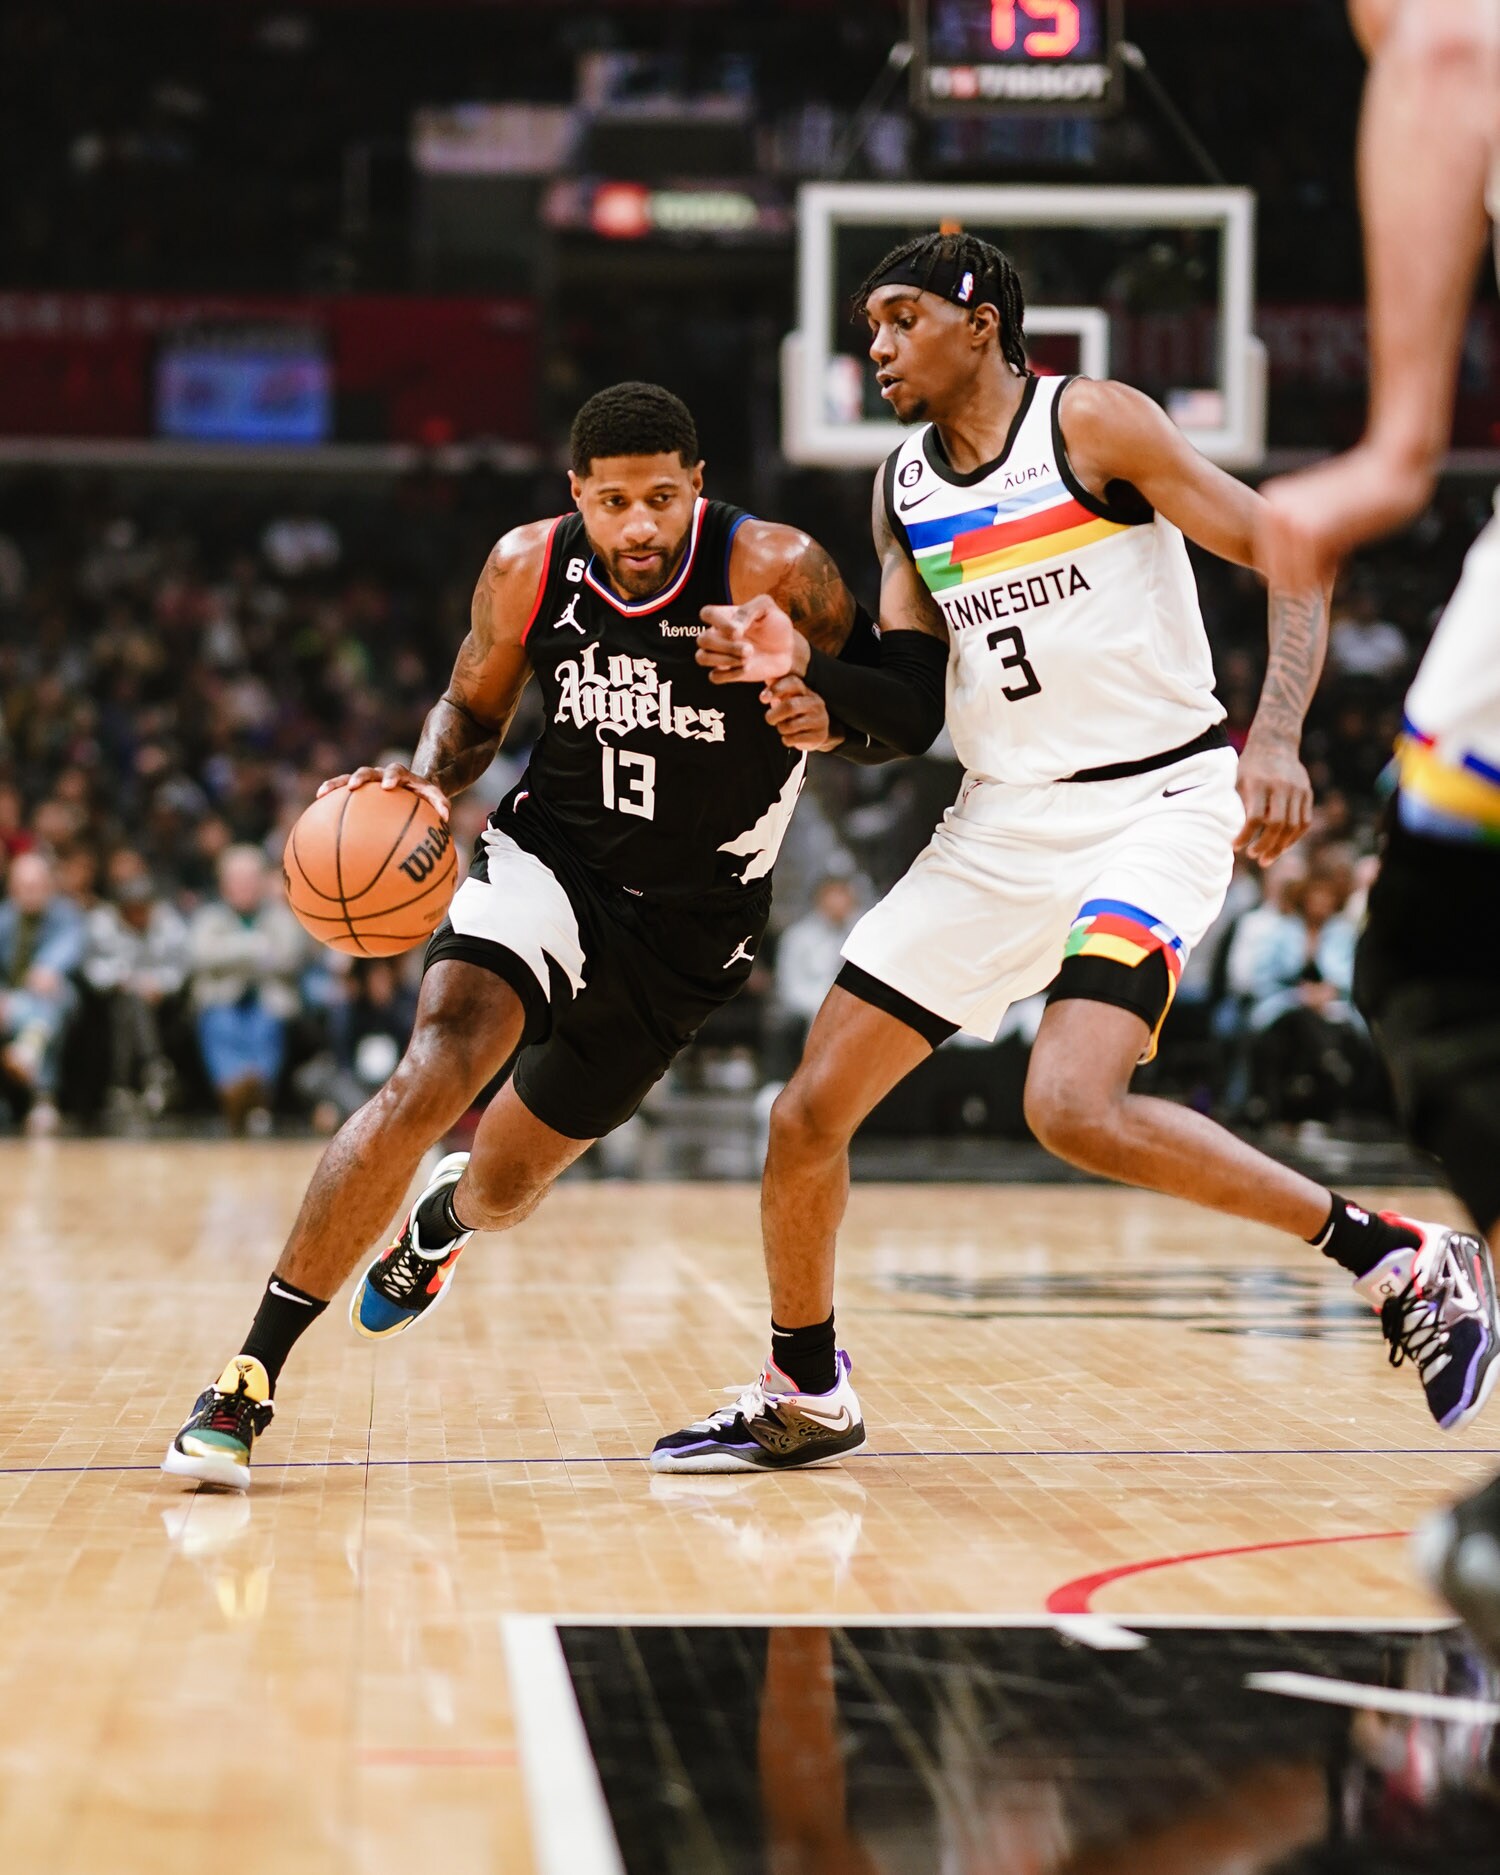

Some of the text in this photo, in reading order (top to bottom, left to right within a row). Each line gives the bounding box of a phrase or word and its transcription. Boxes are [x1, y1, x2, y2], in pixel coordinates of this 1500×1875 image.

[902, 461, 921, 487] 6
[565, 557, 585, 583] 6
[943, 563, 1091, 631] INNESOTA
[658, 619, 706, 638] honey
[580, 641, 657, 694] Los
[986, 625, 1042, 702] 3
[554, 658, 725, 746] Angeles
[602, 746, 656, 821] 13
